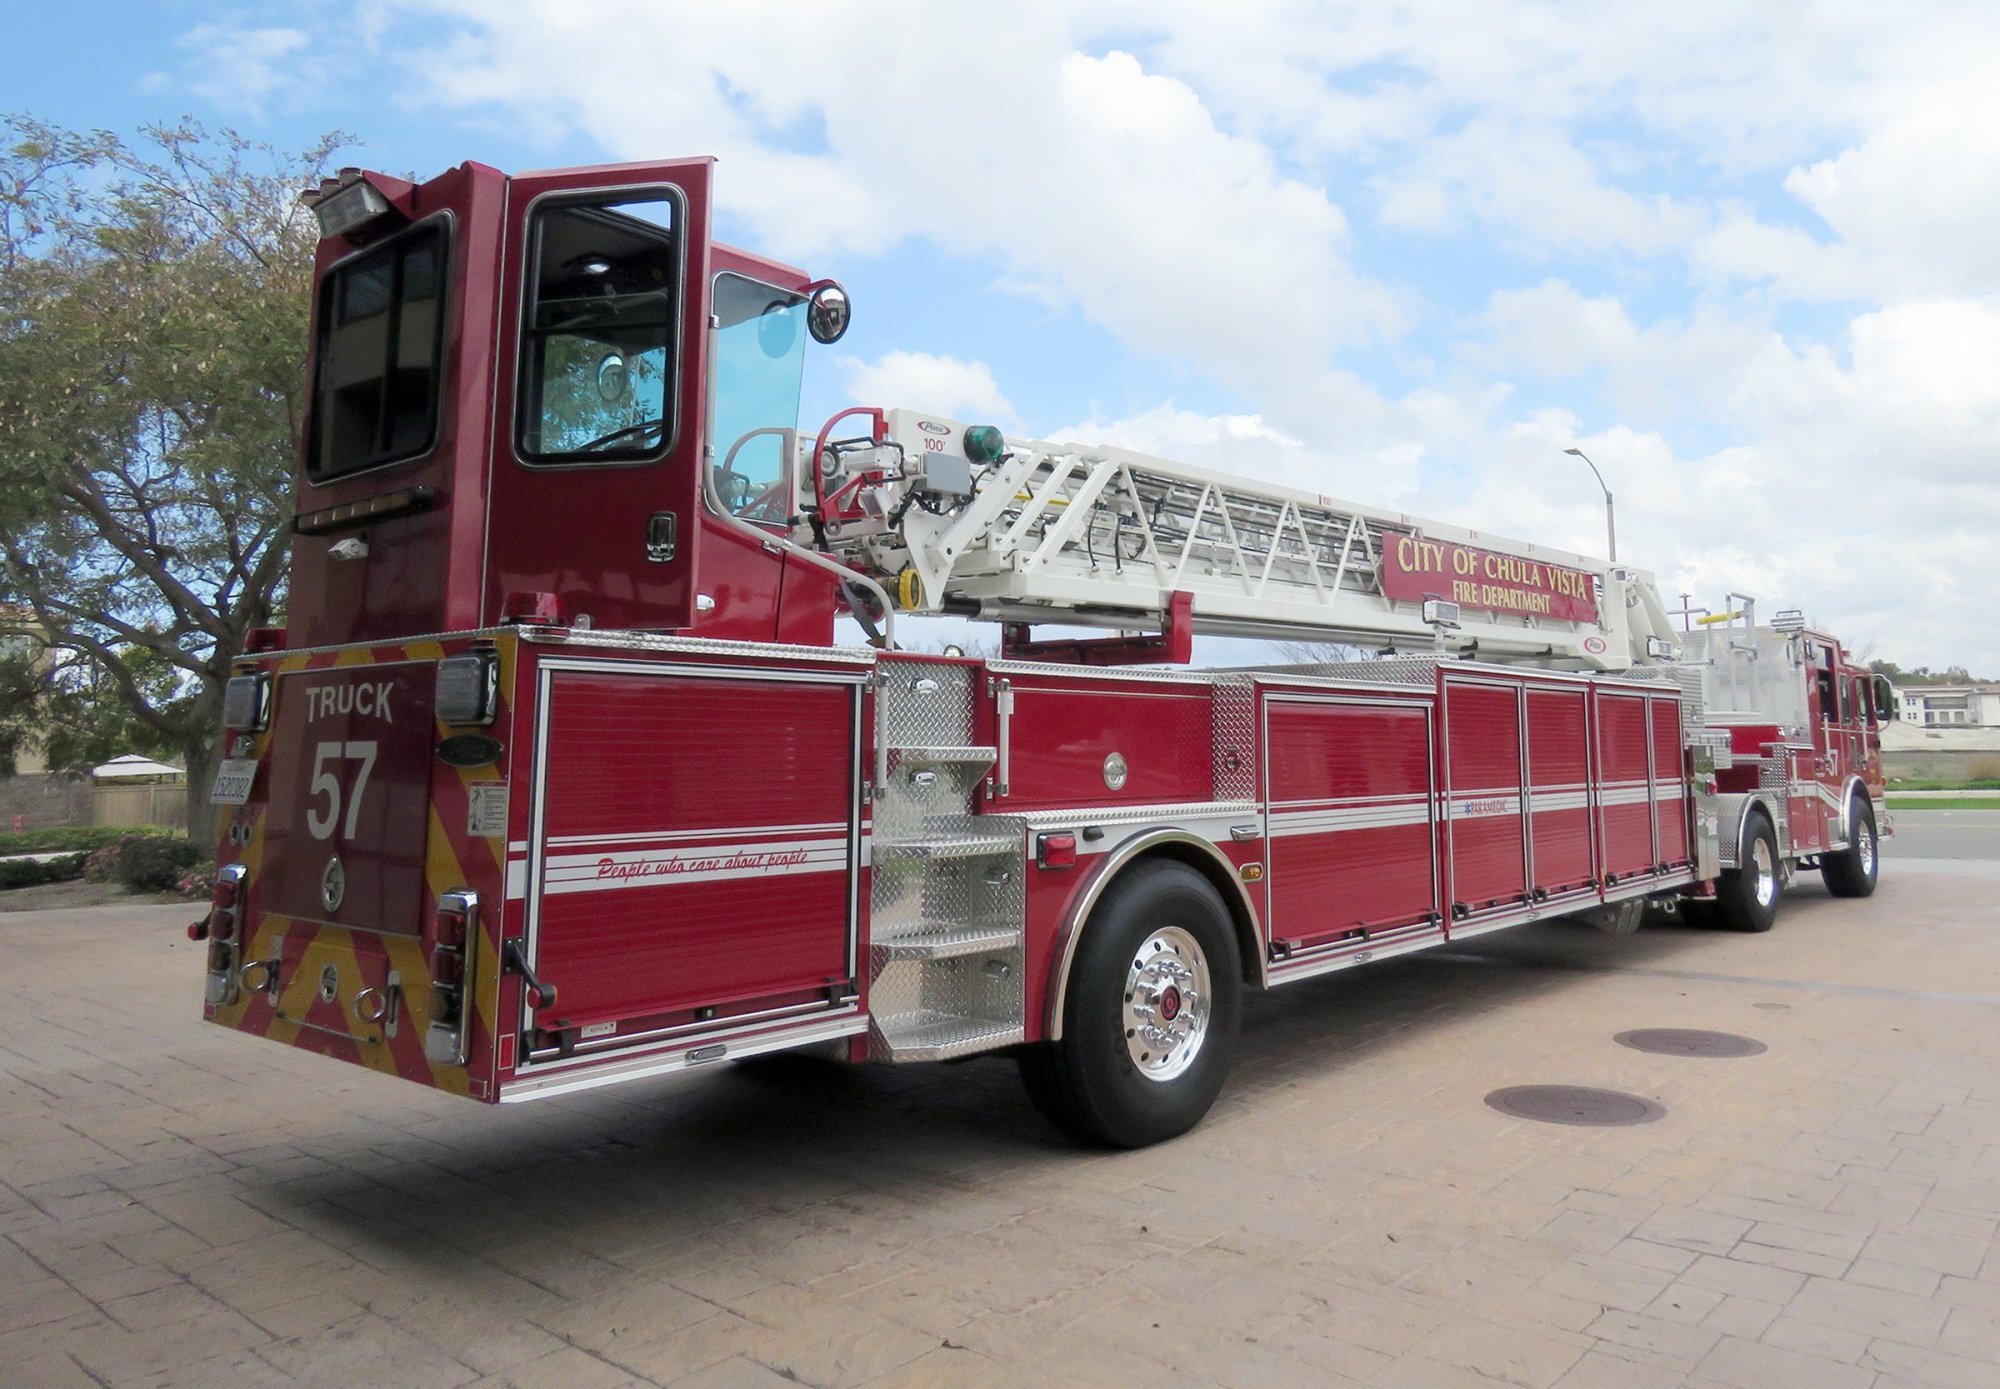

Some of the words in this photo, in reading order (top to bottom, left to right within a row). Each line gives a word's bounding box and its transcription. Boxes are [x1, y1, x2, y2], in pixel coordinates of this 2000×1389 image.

[1398, 538, 1445, 573] CITY
[1452, 549, 1478, 576] OF
[1484, 555, 1542, 588] CHULA
[1546, 567, 1587, 601] VISTA
[1452, 580, 1477, 604] FIRE
[1482, 584, 1550, 614] DEPARTMENT
[305, 682, 394, 724] TRUCK
[307, 741, 378, 840] 57
[1471, 799, 1507, 816] PARAMEDIC
[597, 858, 650, 883] People
[656, 855, 684, 875] who
[689, 859, 720, 872] care
[725, 850, 764, 870] about
[765, 848, 808, 873] people
